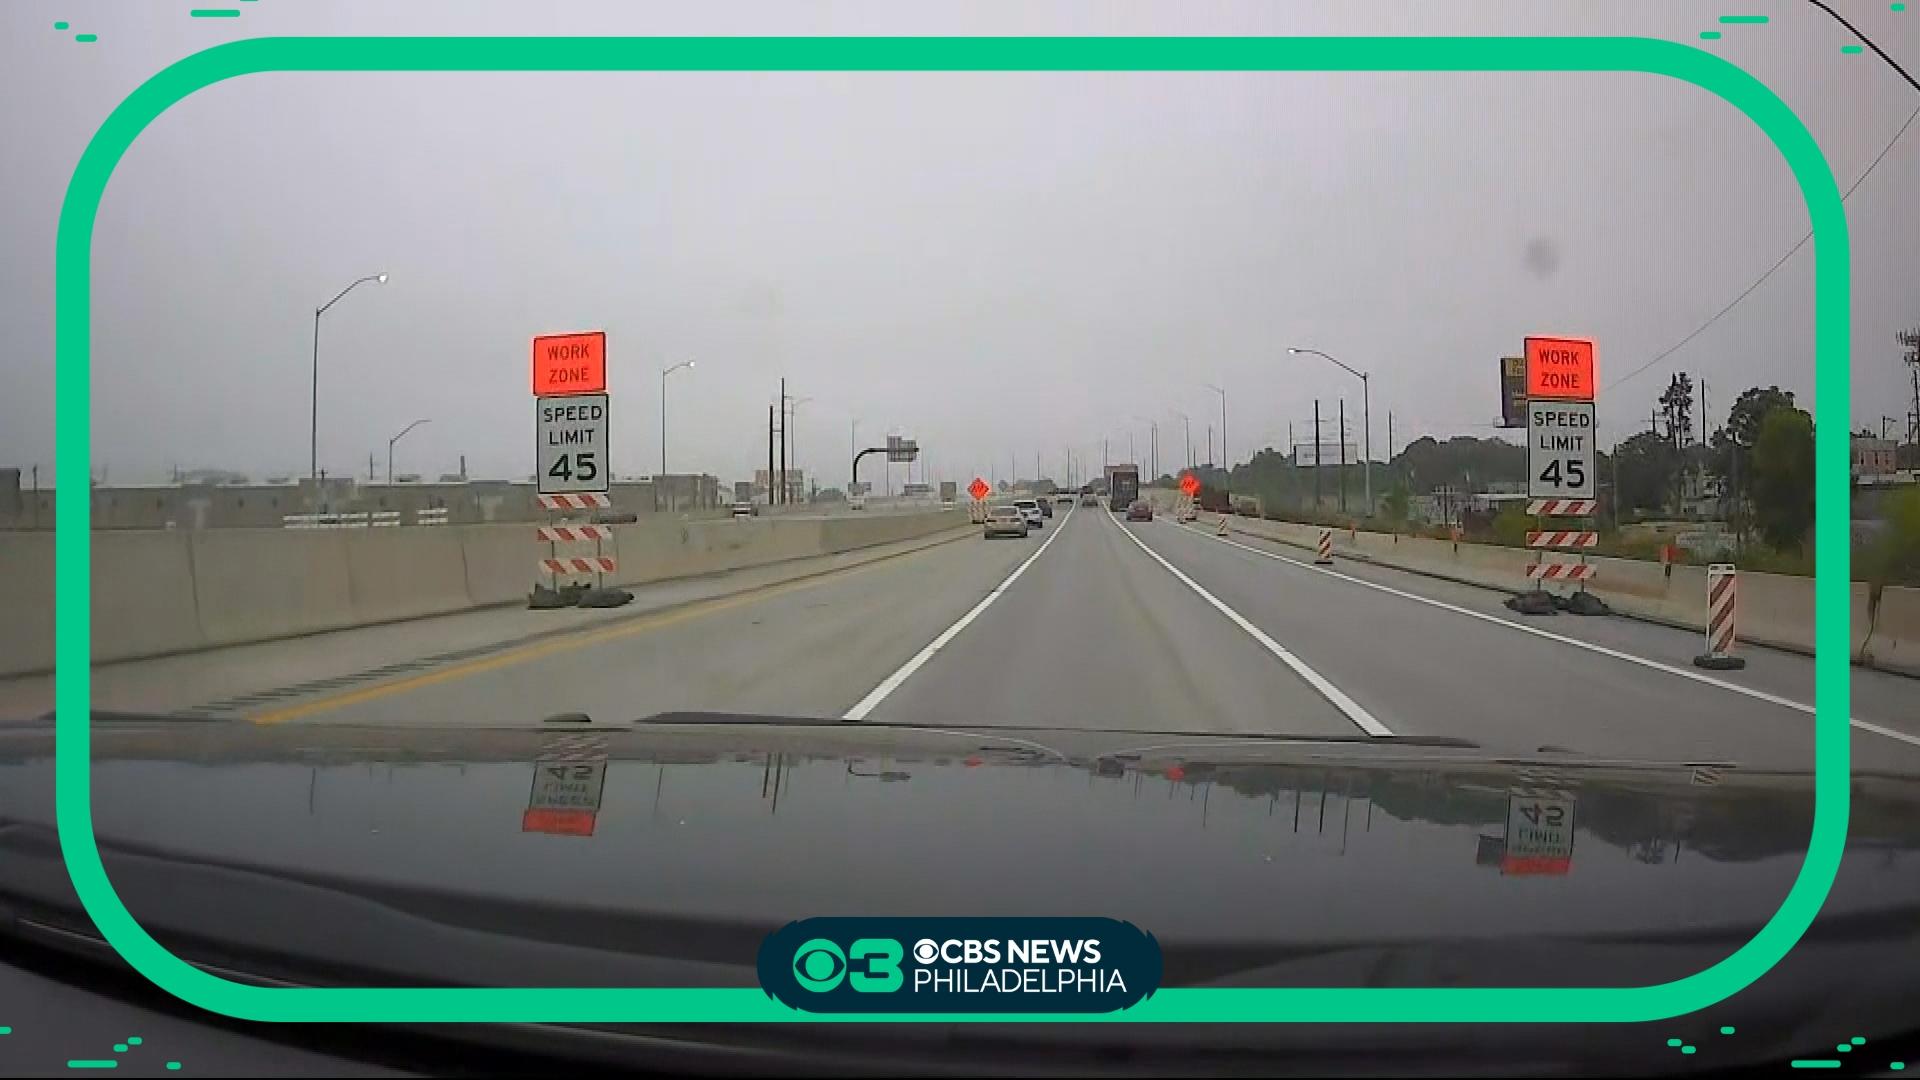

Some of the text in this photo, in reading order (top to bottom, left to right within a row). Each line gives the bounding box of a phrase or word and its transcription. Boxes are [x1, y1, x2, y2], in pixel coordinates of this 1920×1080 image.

[548, 344, 589, 360] WORK
[1539, 349, 1579, 365] WORK
[549, 367, 589, 384] ZONE
[1541, 372, 1580, 389] ZONE
[544, 406, 602, 422] SPEED
[1534, 411, 1589, 427] SPEED
[549, 429, 594, 445] LIMIT
[1540, 435, 1584, 450] LIMIT
[549, 453, 597, 481] 45
[1540, 459, 1585, 488] 45
